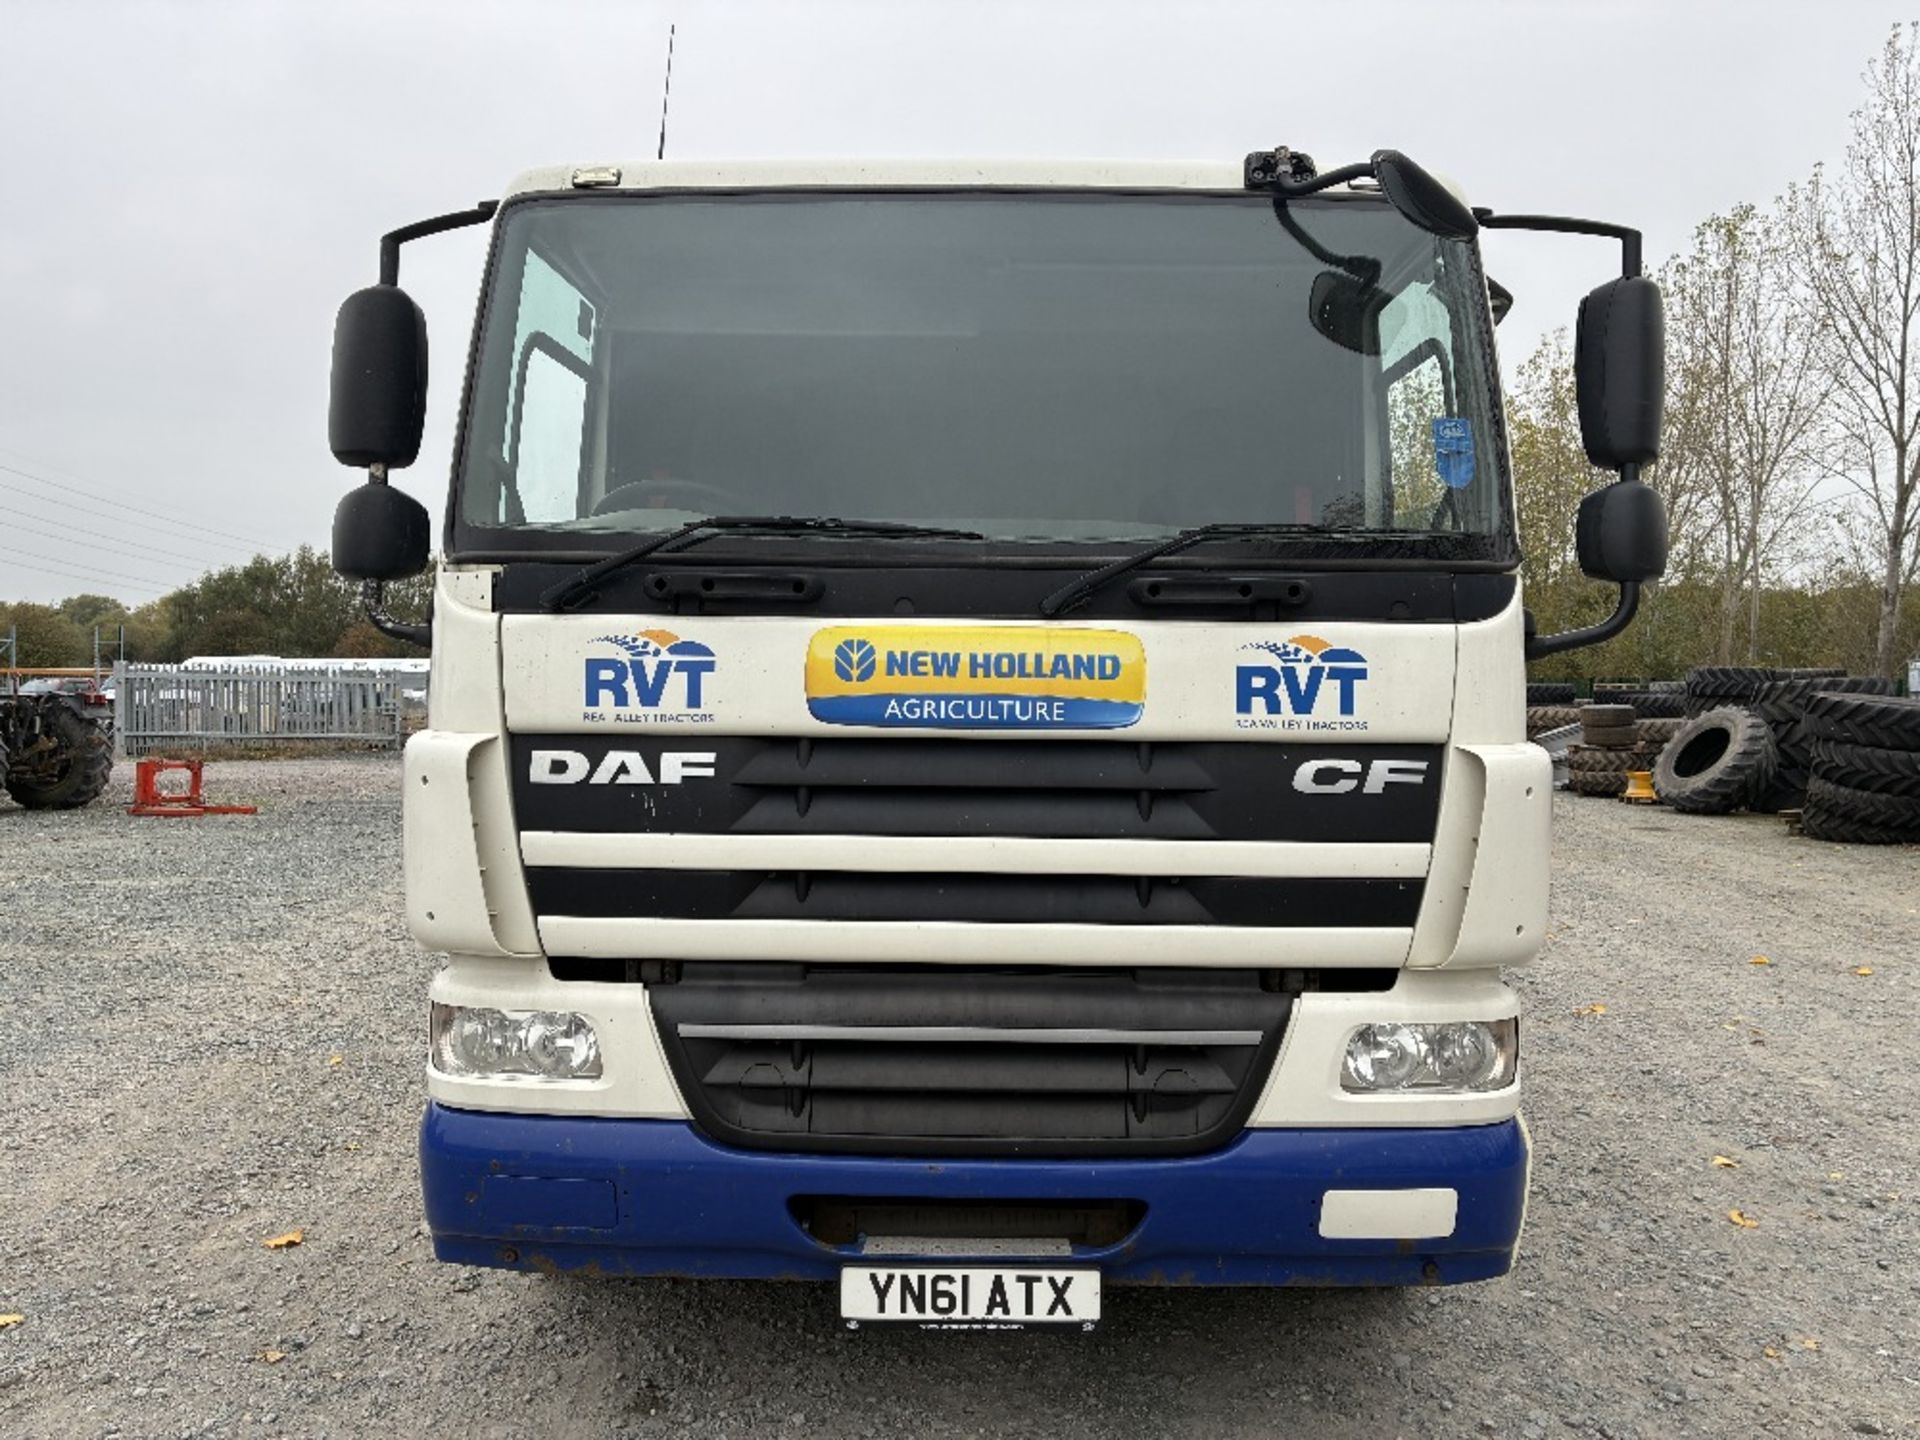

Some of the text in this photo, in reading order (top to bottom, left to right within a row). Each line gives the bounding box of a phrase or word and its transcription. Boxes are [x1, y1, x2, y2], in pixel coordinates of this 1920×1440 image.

[885, 650, 1121, 681] NEW HOLLAND
[585, 658, 716, 709] RVT
[1236, 665, 1368, 716] RVT
[884, 698, 1065, 721] AGRICULTURE
[529, 750, 717, 784] DAF
[1291, 759, 1429, 794] CF
[869, 1273, 1074, 1316] YN61 ATX
